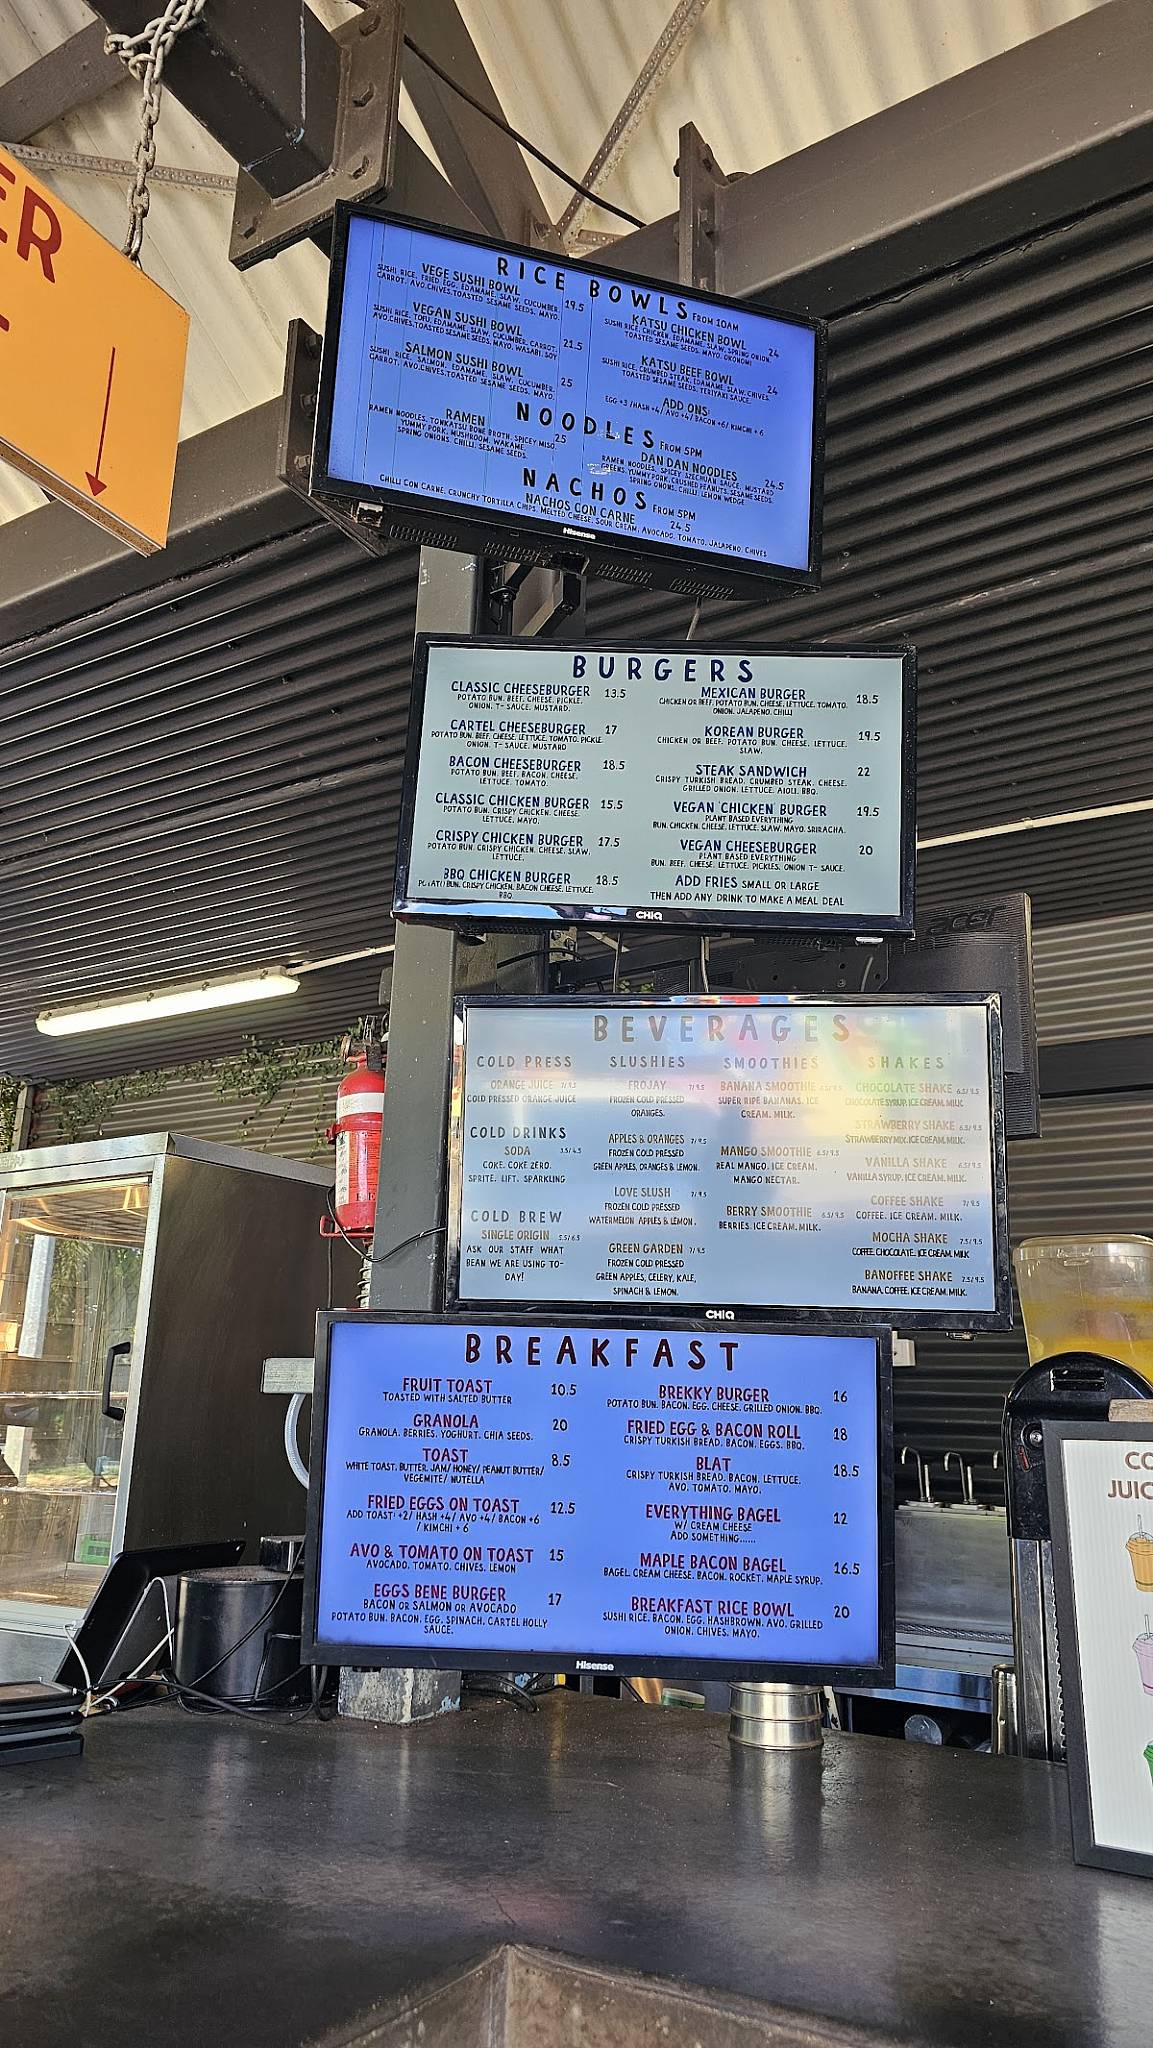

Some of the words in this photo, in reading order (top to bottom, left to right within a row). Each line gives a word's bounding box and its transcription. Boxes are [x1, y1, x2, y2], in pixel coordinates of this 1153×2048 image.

[421, 262, 449, 280] VEGE
[452, 270, 485, 287] SUSHI
[488, 278, 520, 296] BOWL
[564, 299, 584, 312] 19.5
[497, 256, 565, 292] RICE
[589, 278, 688, 320] BOWLS
[692, 312, 714, 325] FROM
[715, 318, 739, 332] 10AM
[631, 313, 667, 331] KATSU
[670, 323, 714, 343] CHICKEN
[716, 334, 746, 350] BOWL
[767, 347, 779, 358] 24
[661, 397, 684, 411] ADD
[445, 408, 485, 426] RAMEN
[554, 433, 567, 444] 25
[516, 401, 654, 449] NOODLES
[659, 440, 681, 454] FROM
[683, 446, 702, 458] 5PM
[640, 451, 664, 466] DAN
[666, 456, 689, 472] DAN
[692, 462, 737, 482] NOODLES
[764, 478, 784, 491] 24.5
[523, 467, 646, 510] NACHOS
[652, 503, 674, 517] FROM
[676, 508, 696, 521] 5PM
[525, 492, 571, 511] NACHOS
[573, 502, 597, 516] CON
[599, 507, 635, 525] CARNE
[669, 520, 691, 532] 24.5
[563, 527, 597, 540] Hisense
[572, 654, 753, 683] BURGERS
[450, 680, 500, 693] CLASSIC
[503, 682, 590, 697] CHEESEBURGER
[604, 688, 626, 698] 13.5
[700, 686, 756, 699] MEXICAN
[759, 687, 806, 700] BURGER
[856, 693, 878, 704] 18.5
[450, 718, 495, 732] CARTEL
[498, 720, 586, 735] CHEESEBURGER
[605, 724, 617, 735] 17
[704, 725, 754, 738] KOREAN
[757, 726, 804, 739] BURGER
[858, 730, 880, 741] 19.5
[695, 763, 734, 776] STEAK
[738, 765, 807, 778] SANDWICH
[857, 766, 870, 777] 22
[435, 792, 485, 805] CLASSIC
[488, 794, 540, 808] CHICKEN
[543, 796, 589, 810] BURGER
[600, 799, 623, 810] 15.5
[673, 800, 714, 813] VEGAN
[779, 803, 827, 817] BURGER
[856, 805, 880, 817] 19.5
[704, 814, 727, 822] PLANT
[728, 814, 750, 823] BASED
[751, 815, 793, 824] EVERYTHING
[674, 874, 701, 887] ADD
[705, 875, 738, 888] FRIES
[741, 879, 772, 889] SMALL
[773, 880, 787, 890] OR
[789, 881, 819, 891] LARGE
[928, 905, 1007, 934] acer
[593, 1012, 850, 1043] BEVERAGES
[476, 1055, 515, 1068] COLD
[524, 1055, 572, 1068] PRESS
[609, 1055, 685, 1068] SLUSHIES
[723, 1055, 817, 1070] SMOOTHIES
[868, 1055, 944, 1069] SHAKES
[469, 1126, 505, 1138] COLD
[512, 1126, 566, 1139] DRINKS
[608, 1133, 637, 1144] APPLES
[638, 1134, 645, 1144] &
[646, 1133, 684, 1144] ORANGES
[503, 1145, 531, 1156] SODA
[608, 1148, 634, 1157] FROZEN
[635, 1148, 654, 1157] COLD
[655, 1148, 684, 1158] PRESSED
[720, 1145, 757, 1158] MANGO
[761, 1145, 811, 1158] SMOOTHIE
[614, 1186, 638, 1198] LOVE
[640, 1187, 671, 1198] SLUSH
[470, 1209, 509, 1222] COLD
[519, 1210, 562, 1224] BREW
[726, 1205, 757, 1218] BERRY
[760, 1206, 812, 1219] SMOOTHIE
[480, 1229, 514, 1240] SINGLE
[516, 1229, 549, 1241] ORIGIN
[872, 1231, 910, 1243] MOCHA
[913, 1232, 947, 1245] SHAKE
[466, 1244, 482, 1254] ASK
[488, 1244, 504, 1254] OUR
[509, 1245, 534, 1255] STAFF
[540, 1245, 564, 1255] WHAT
[608, 1242, 639, 1254] GREEN
[643, 1242, 683, 1255] GARDEN
[864, 1269, 916, 1282] BANOFFEE
[917, 1270, 953, 1282] SHAKE
[465, 1333, 738, 1371] BREAKFAST
[402, 1377, 442, 1392] FRUIT
[445, 1378, 492, 1393] TOAST
[551, 1383, 577, 1396] 10.5
[659, 1384, 712, 1401] BREKKY
[716, 1386, 769, 1403] BURGER
[833, 1390, 847, 1402] 16
[382, 1391, 420, 1402] TOASTED
[423, 1393, 446, 1402] WITH
[447, 1393, 478, 1404] SALTED
[480, 1394, 512, 1404] BUTTER
[412, 1413, 479, 1429] GRANOLA
[552, 1418, 568, 1431] 20
[627, 1419, 665, 1434] FRIED
[669, 1421, 697, 1436] EGG
[701, 1422, 711, 1437] &
[715, 1422, 763, 1438] BACON
[767, 1424, 801, 1440] ROLL
[833, 1427, 848, 1441] 18
[483, 1430, 504, 1440] CHIA
[421, 1447, 468, 1463] TOAST
[551, 1453, 570, 1467] 8.5
[696, 1456, 731, 1472] BLAT
[833, 1463, 859, 1477] 18.5
[645, 1503, 733, 1521] EVERYTHING
[737, 1506, 781, 1523] BAGEL
[833, 1511, 848, 1525] 12
[674, 1520, 688, 1530] W/
[690, 1520, 720, 1531] CREAM
[722, 1522, 752, 1532] CHEESE
[373, 1583, 410, 1598] EGGS
[414, 1583, 447, 1600] BENE
[452, 1584, 506, 1602] BURGER
[547, 1592, 562, 1606] 17
[363, 1598, 395, 1610] BACON
[398, 1601, 409, 1610] OR
[412, 1600, 452, 1612] SALMON
[454, 1603, 466, 1612] OR
[468, 1602, 517, 1614] AVOCADO
[575, 1660, 615, 1671] Hisense
